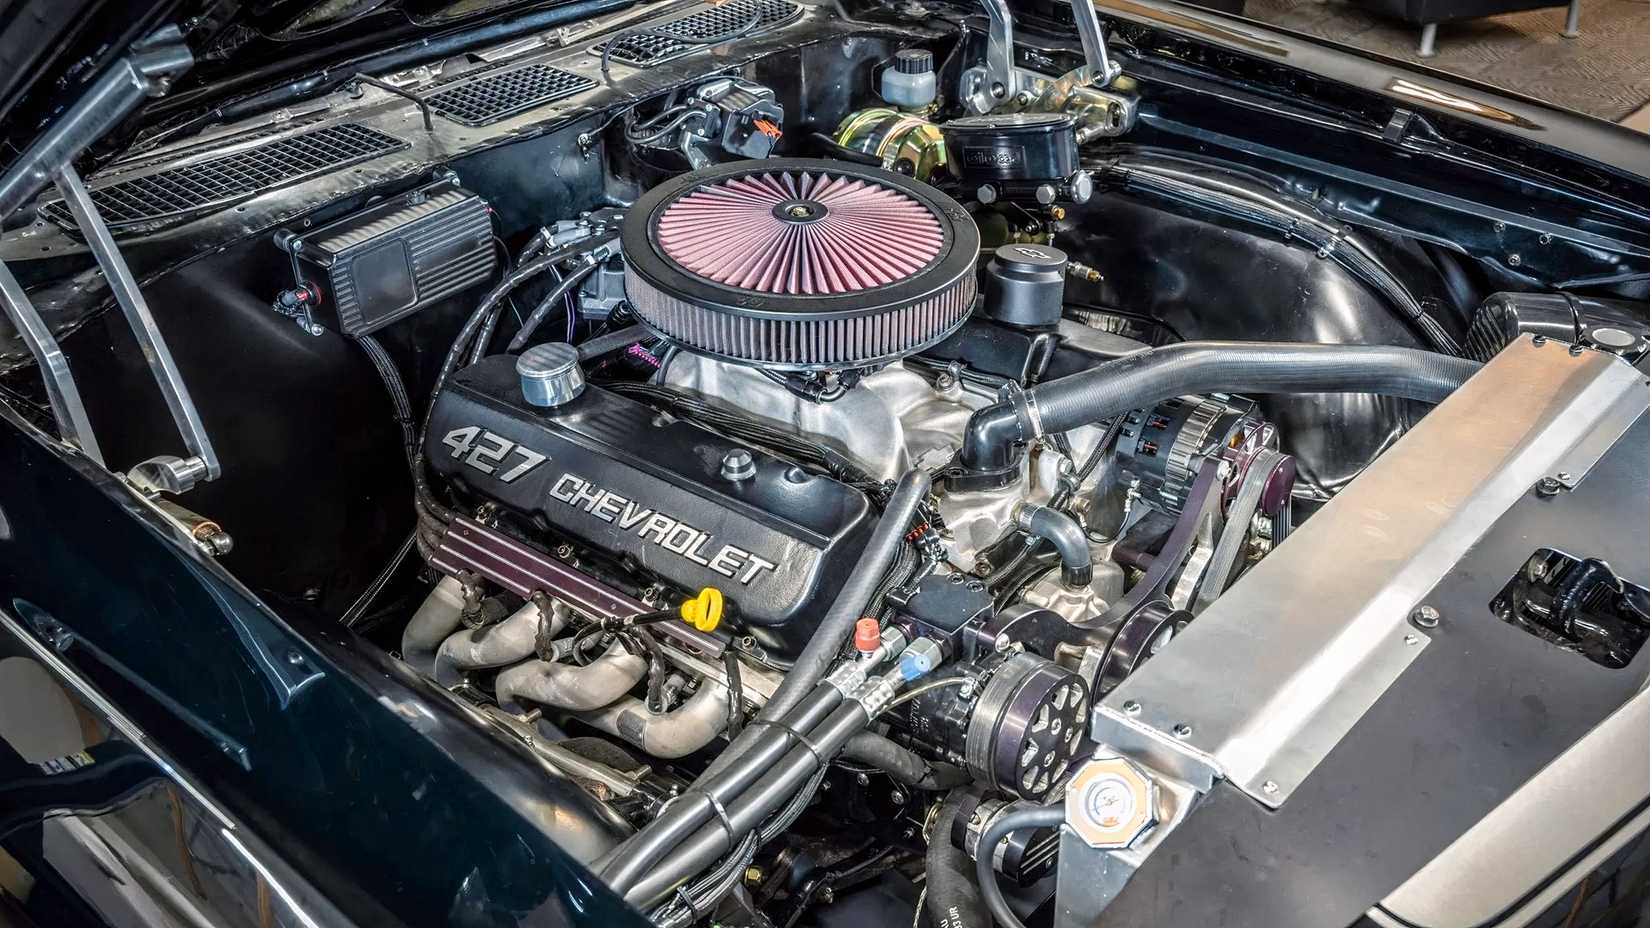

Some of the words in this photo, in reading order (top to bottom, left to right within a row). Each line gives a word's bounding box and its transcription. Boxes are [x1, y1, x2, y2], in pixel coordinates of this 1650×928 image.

[442, 426, 548, 483] 427
[550, 473, 776, 585] CHEVROLET
[949, 906, 959, 920] UR
